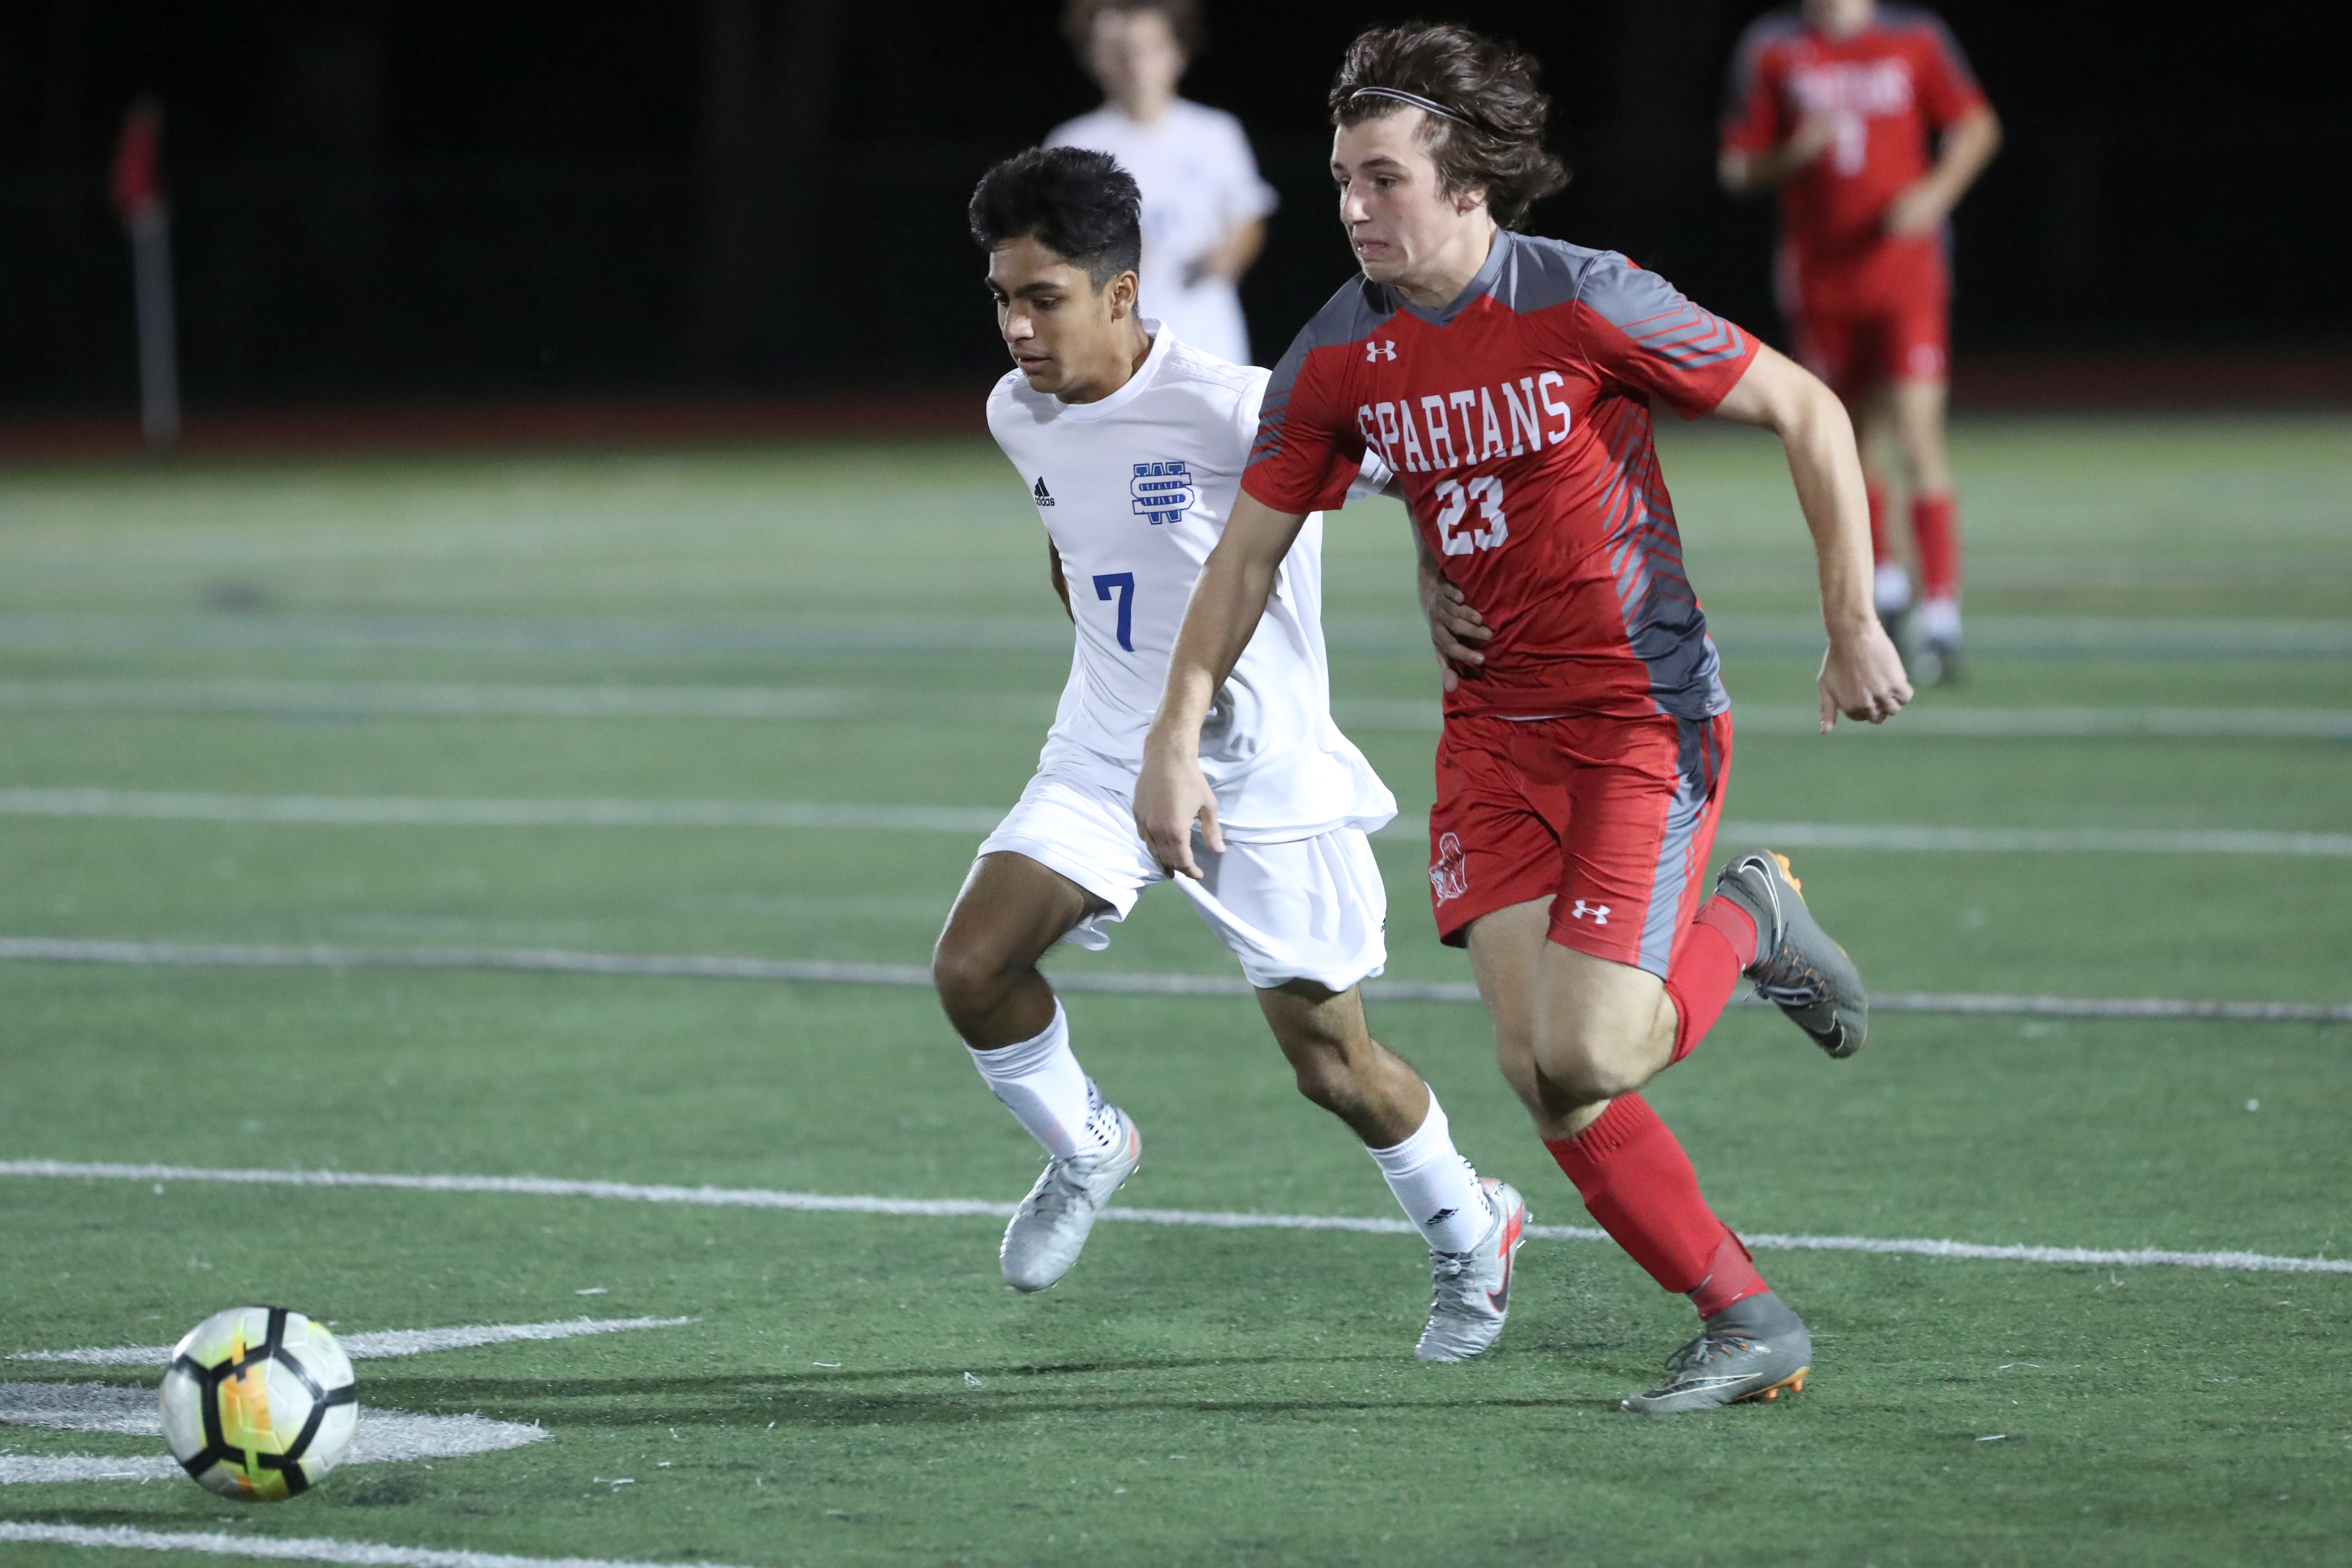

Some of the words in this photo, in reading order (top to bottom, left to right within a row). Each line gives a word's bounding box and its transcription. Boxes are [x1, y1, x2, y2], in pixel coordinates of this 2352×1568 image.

[1357, 370, 1571, 472] SPARTANS
[1434, 475, 1509, 556] 23
[1092, 572, 1135, 652] 7
